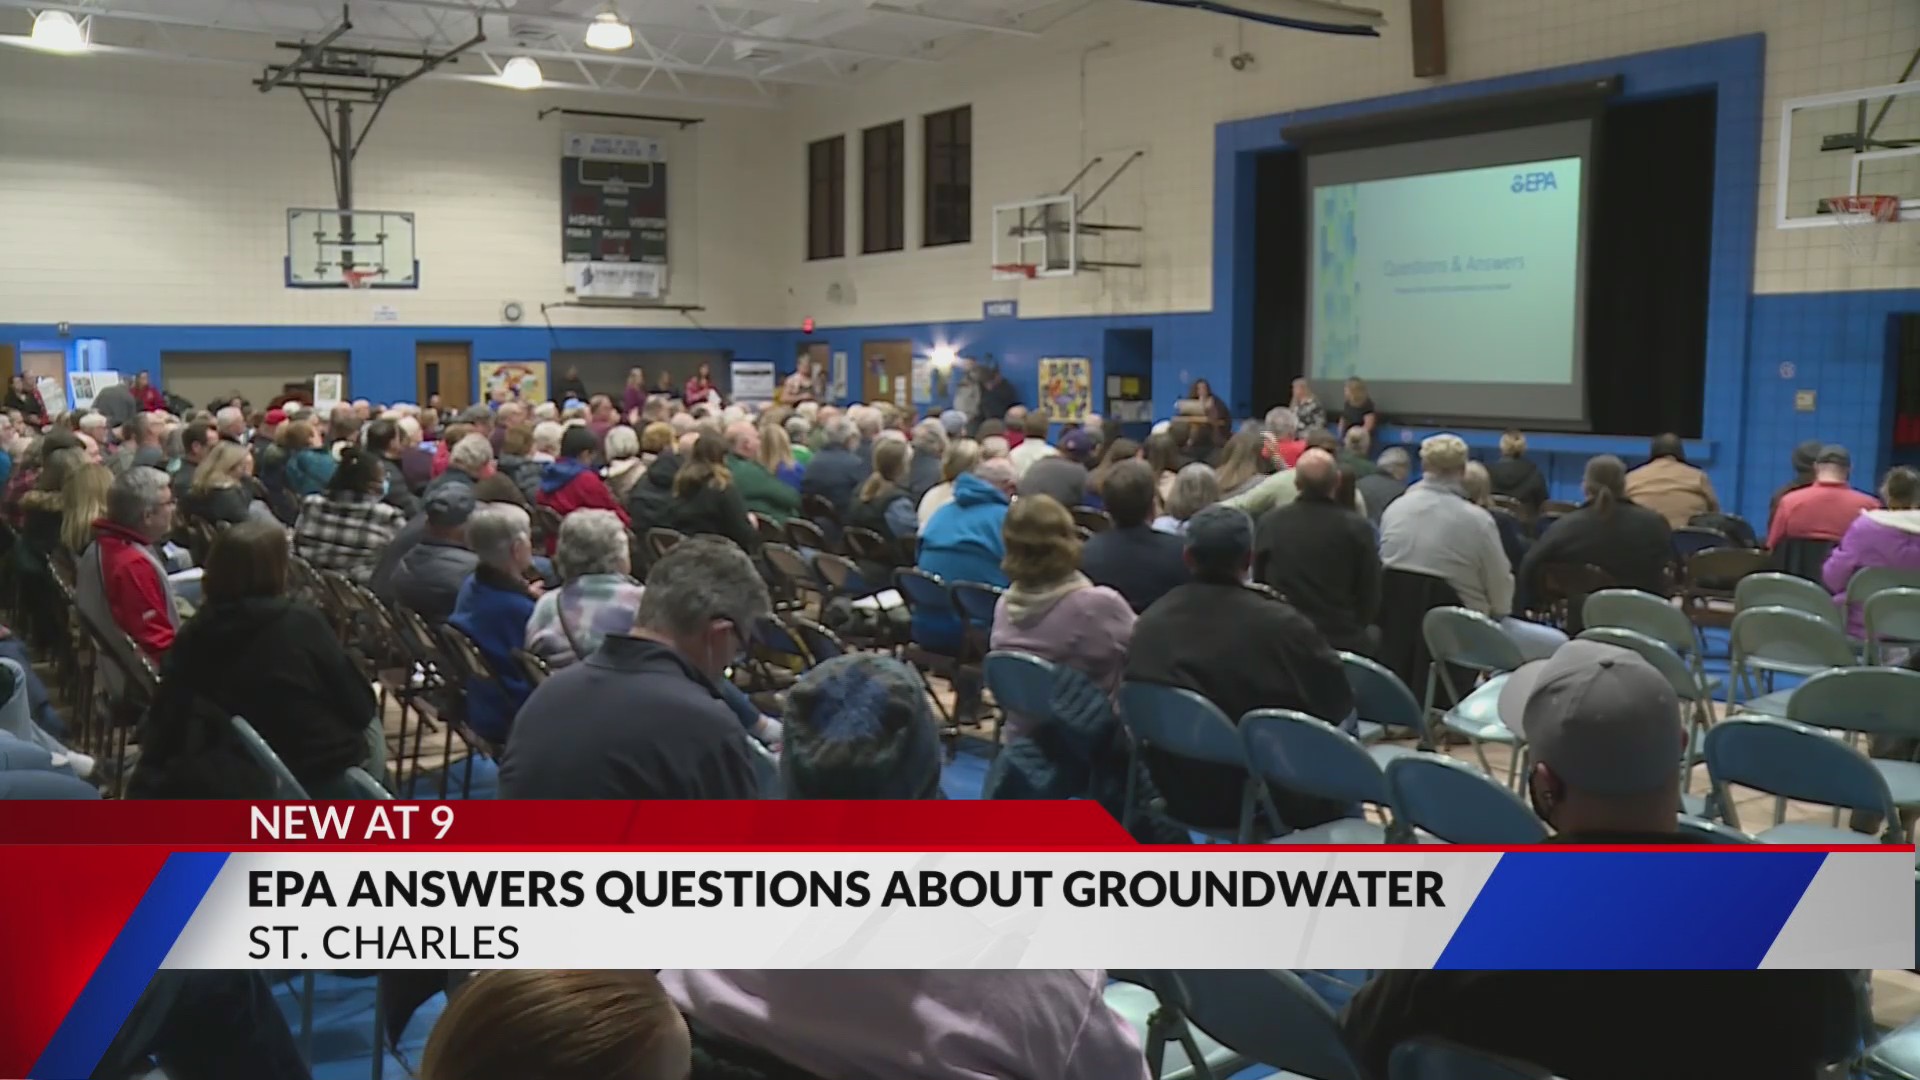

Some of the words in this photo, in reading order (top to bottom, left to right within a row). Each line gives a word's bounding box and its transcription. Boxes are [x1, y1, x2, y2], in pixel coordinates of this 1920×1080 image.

[1525, 171, 1557, 192] EPA
[1384, 260, 1449, 277] Questions
[1451, 255, 1463, 273] &
[1466, 255, 1525, 271] Answers
